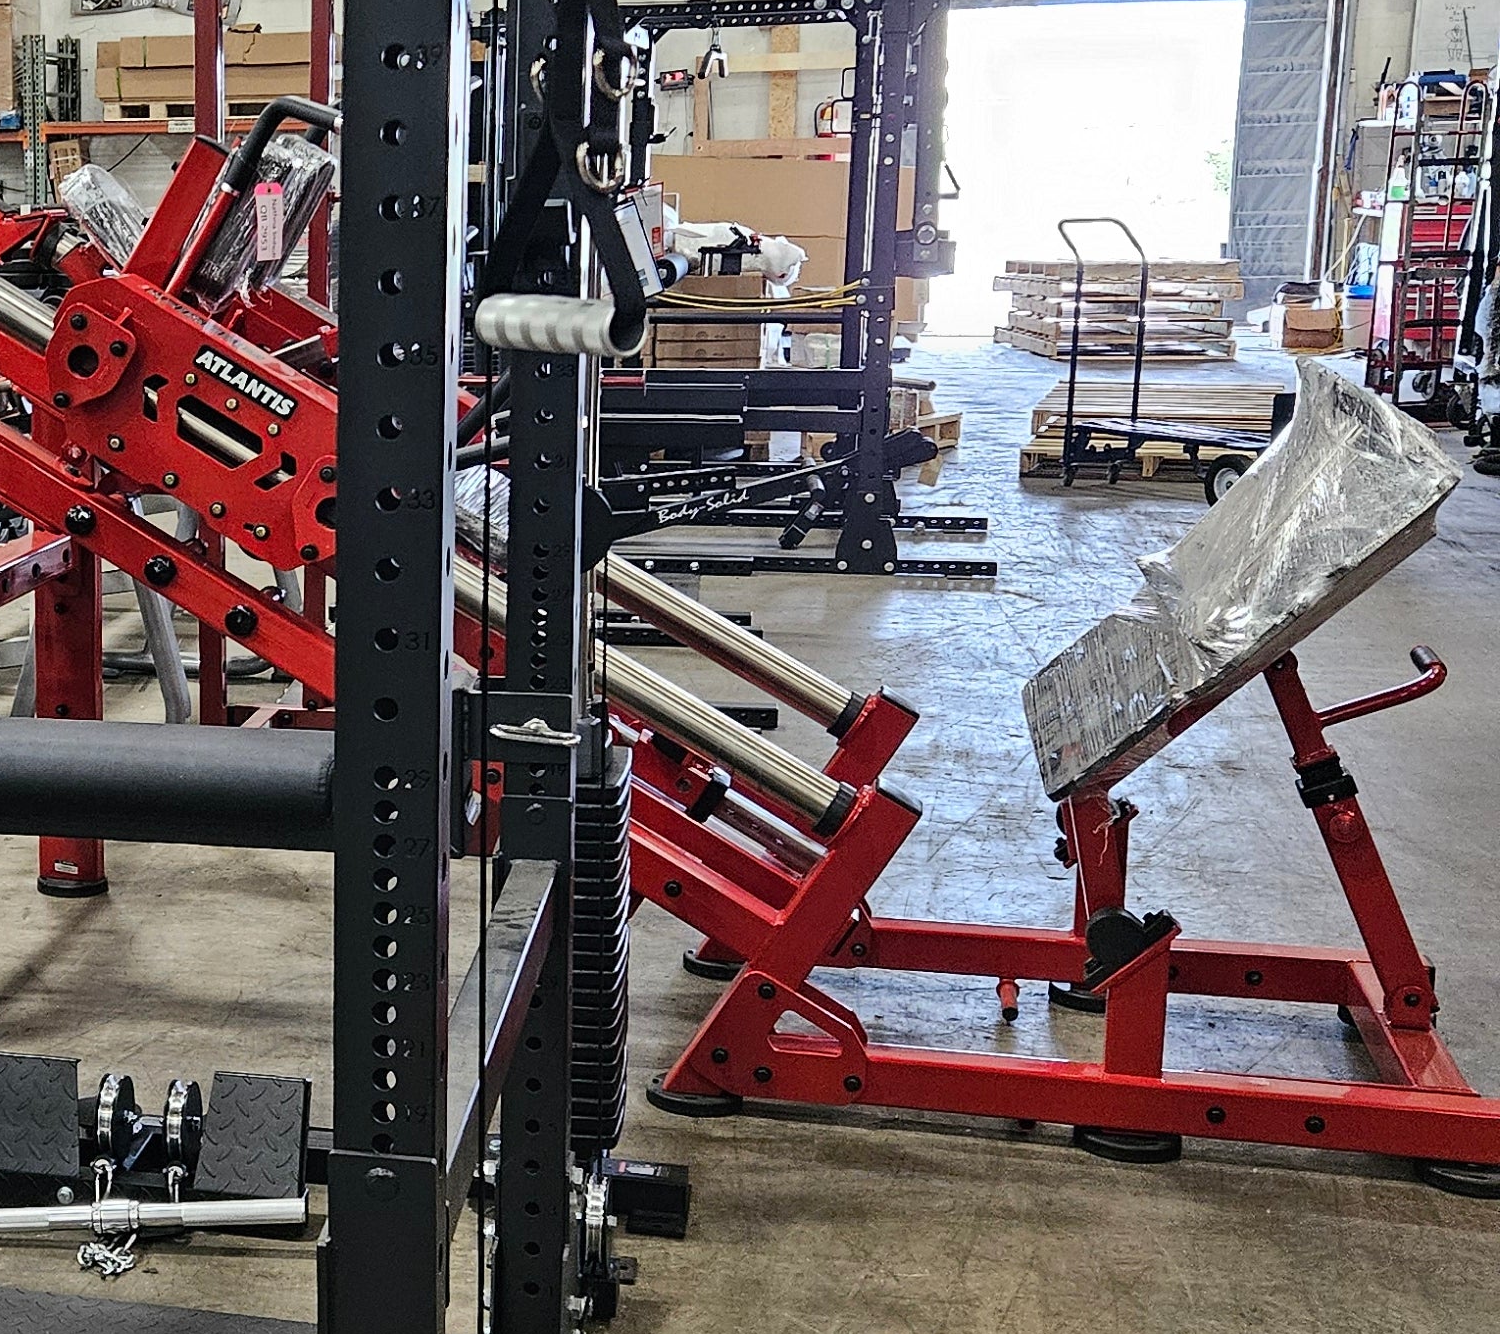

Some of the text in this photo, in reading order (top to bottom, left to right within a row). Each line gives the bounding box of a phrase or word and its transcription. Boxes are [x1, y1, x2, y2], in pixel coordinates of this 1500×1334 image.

[195, 350, 295, 416] ATLANTIS
[657, 488, 750, 524] Body-Solid
[404, 838, 431, 858] 27
